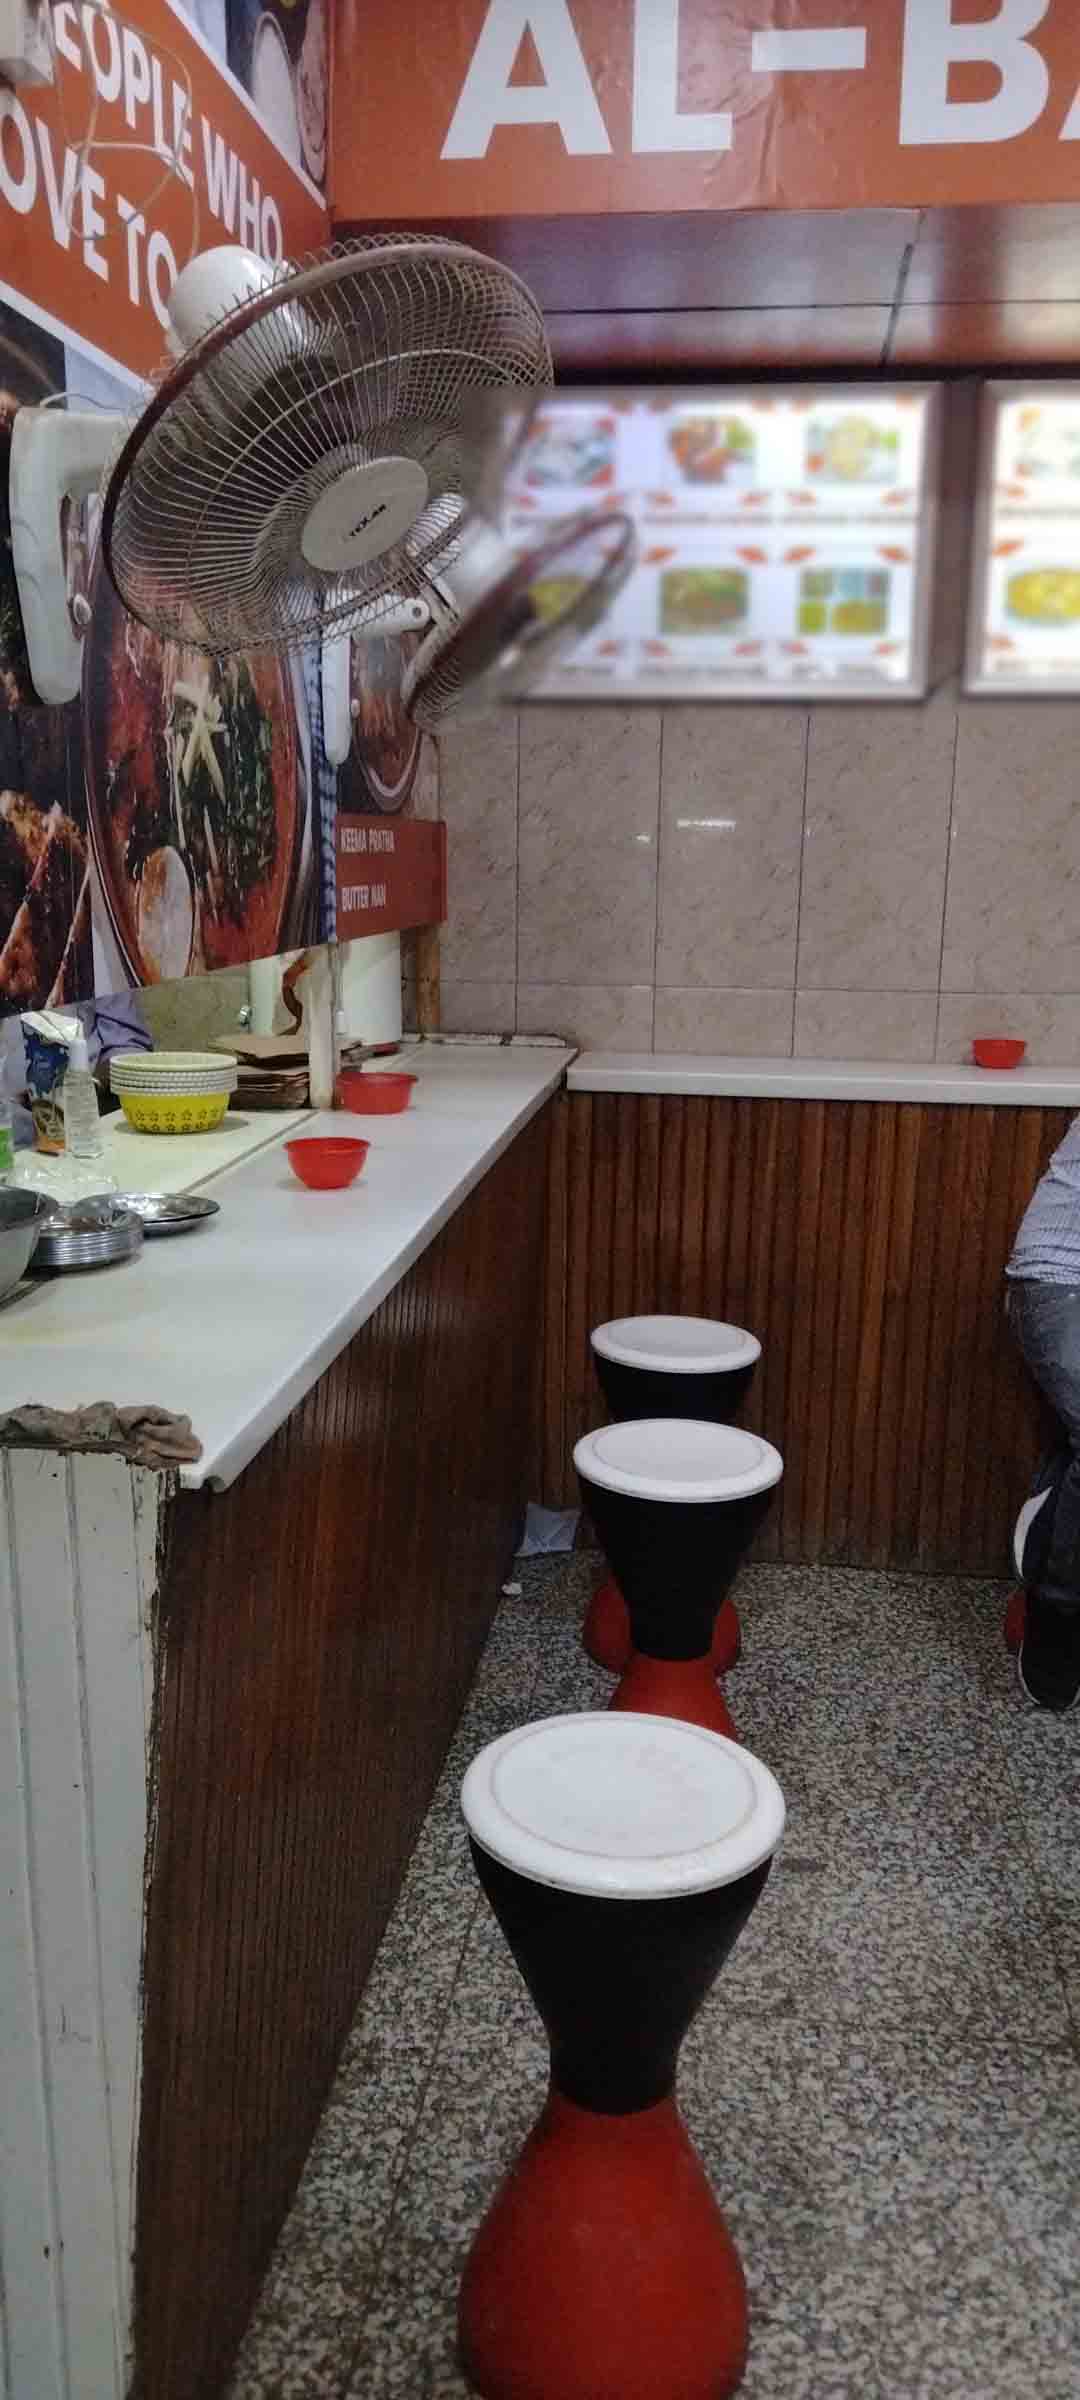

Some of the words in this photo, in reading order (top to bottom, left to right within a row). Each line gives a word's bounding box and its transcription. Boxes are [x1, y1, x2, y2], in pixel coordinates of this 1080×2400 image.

[54, 2, 195, 191] EOPLE
[201, 115, 284, 266] WHO
[440, 0, 1080, 159] AL-B
[0, 93, 109, 282] OVE
[117, 194, 177, 333] TO
[341, 885, 369, 912] BUTTER
